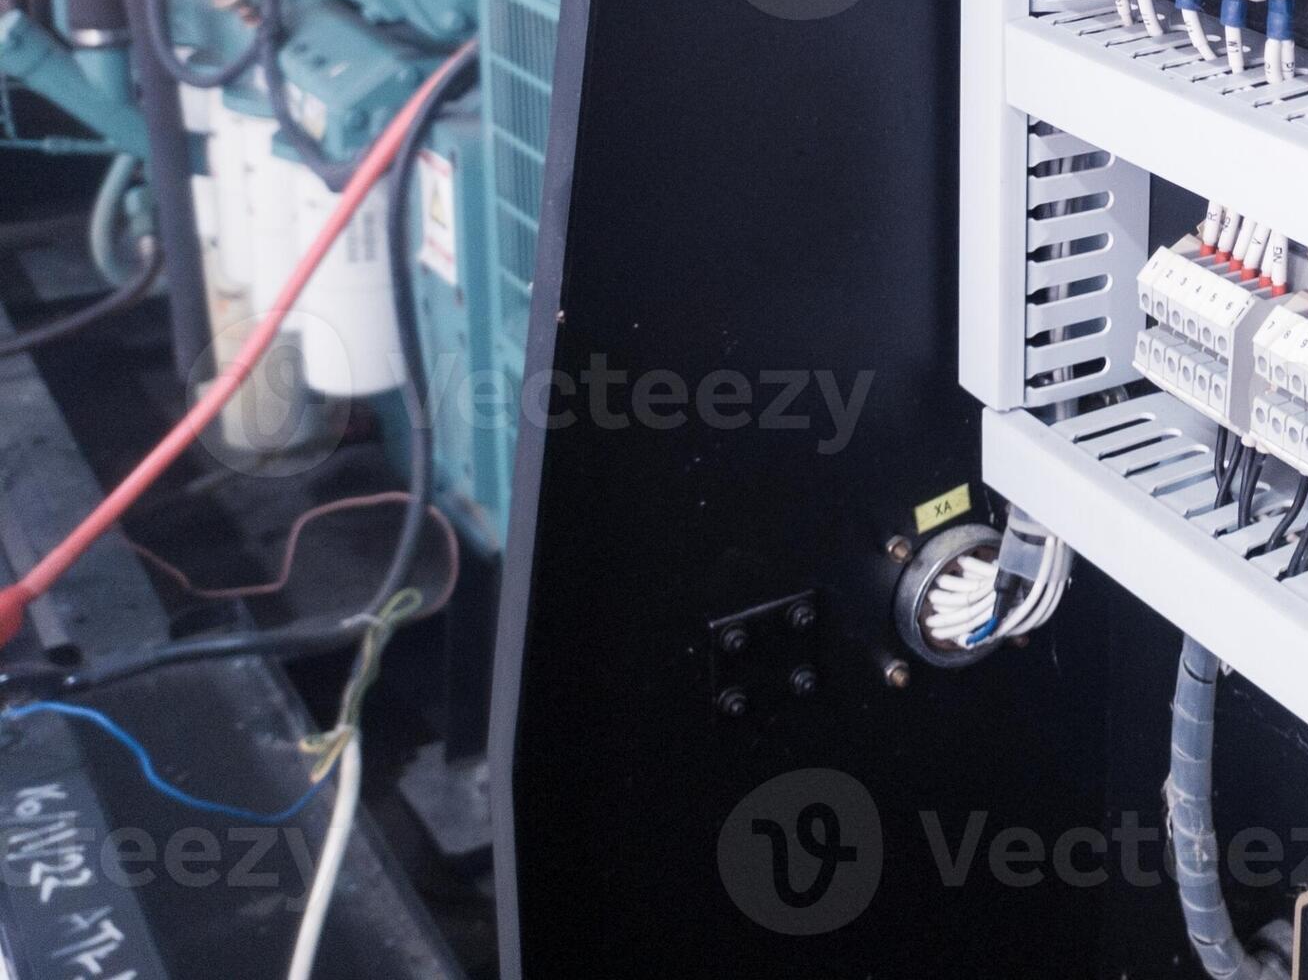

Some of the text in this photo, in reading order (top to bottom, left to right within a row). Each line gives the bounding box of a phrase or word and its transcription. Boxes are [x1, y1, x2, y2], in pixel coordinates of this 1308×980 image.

[1208, 212, 1218, 222] R
[1267, 321, 1275, 330] 7
[1284, 330, 1292, 340] 8
[1300, 339, 1308, 348] 9
[934, 500, 953, 518] XA
